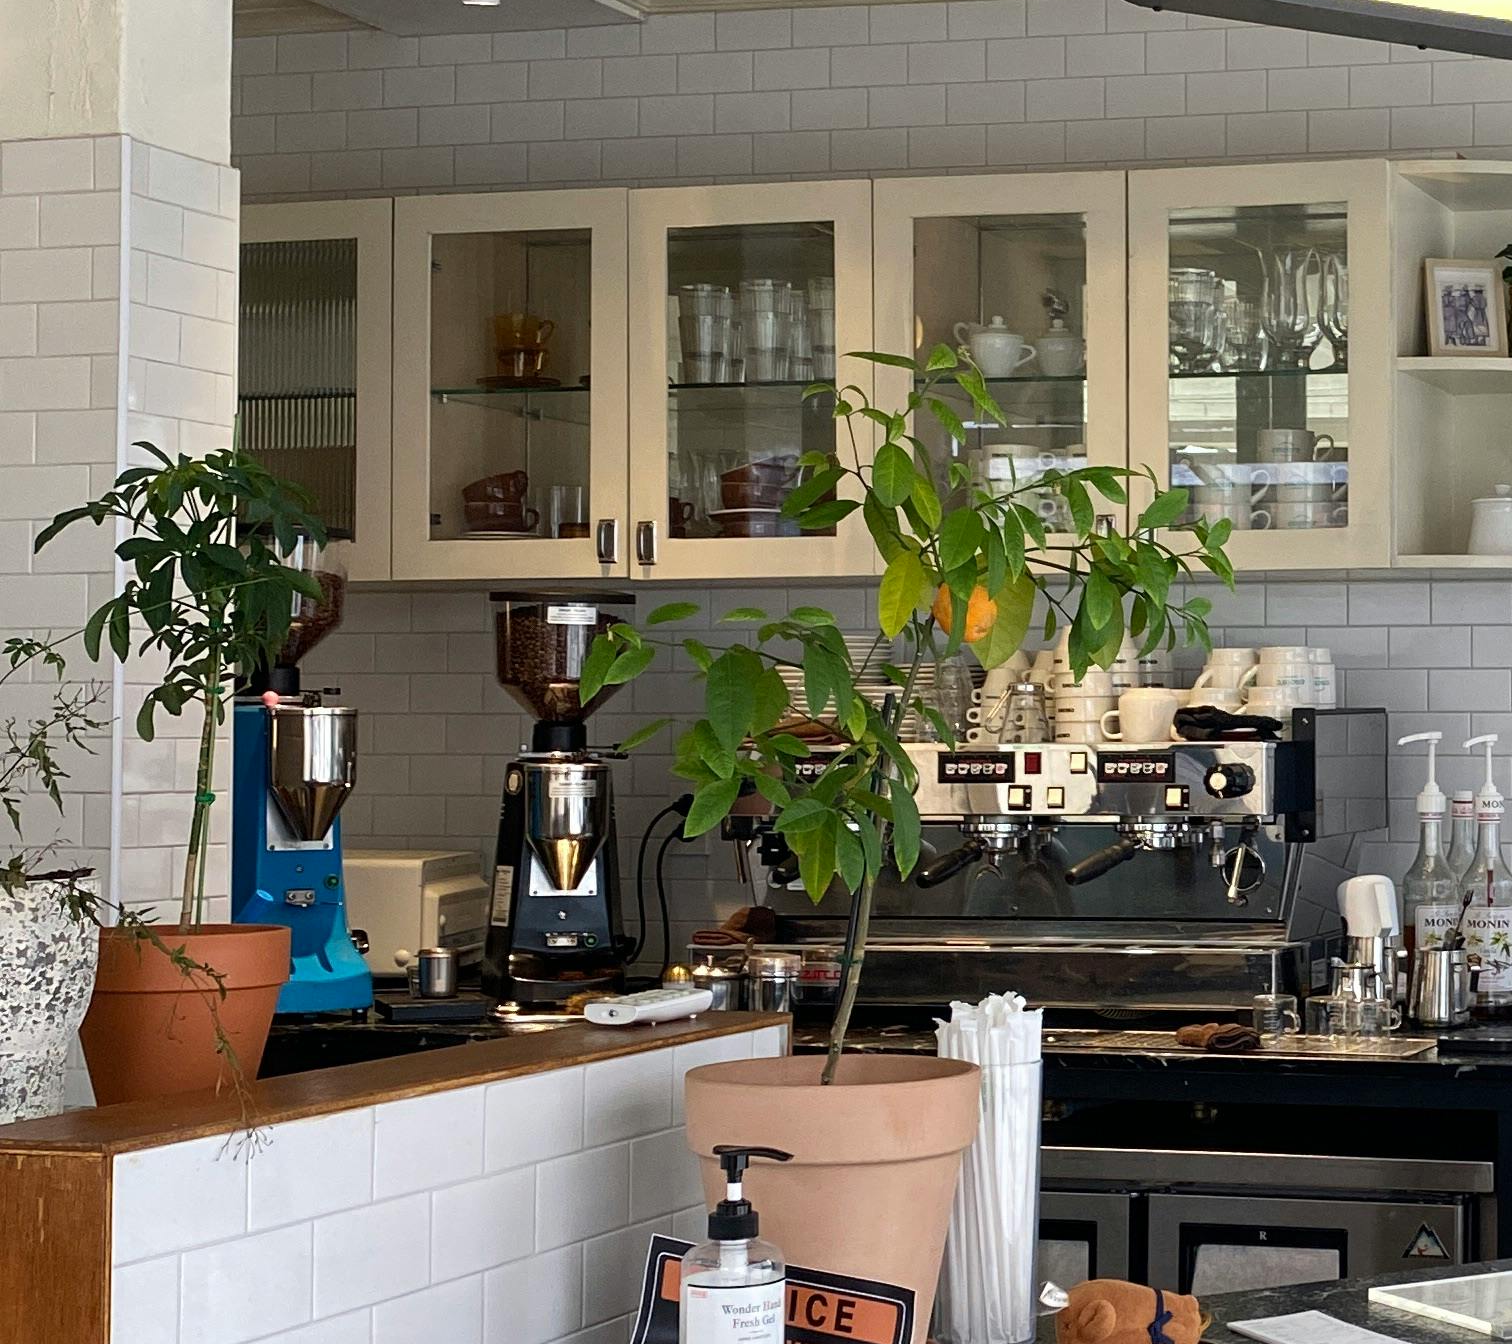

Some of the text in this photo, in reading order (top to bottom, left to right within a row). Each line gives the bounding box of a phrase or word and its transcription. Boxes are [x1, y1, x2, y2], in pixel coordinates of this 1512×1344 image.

[1482, 800, 1505, 809] MON
[1466, 919, 1510, 928] MONIN
[722, 1298, 782, 1315] Wonder Hand
[787, 1289, 856, 1334] ICE
[732, 1314, 776, 1328] Fresh Gel
